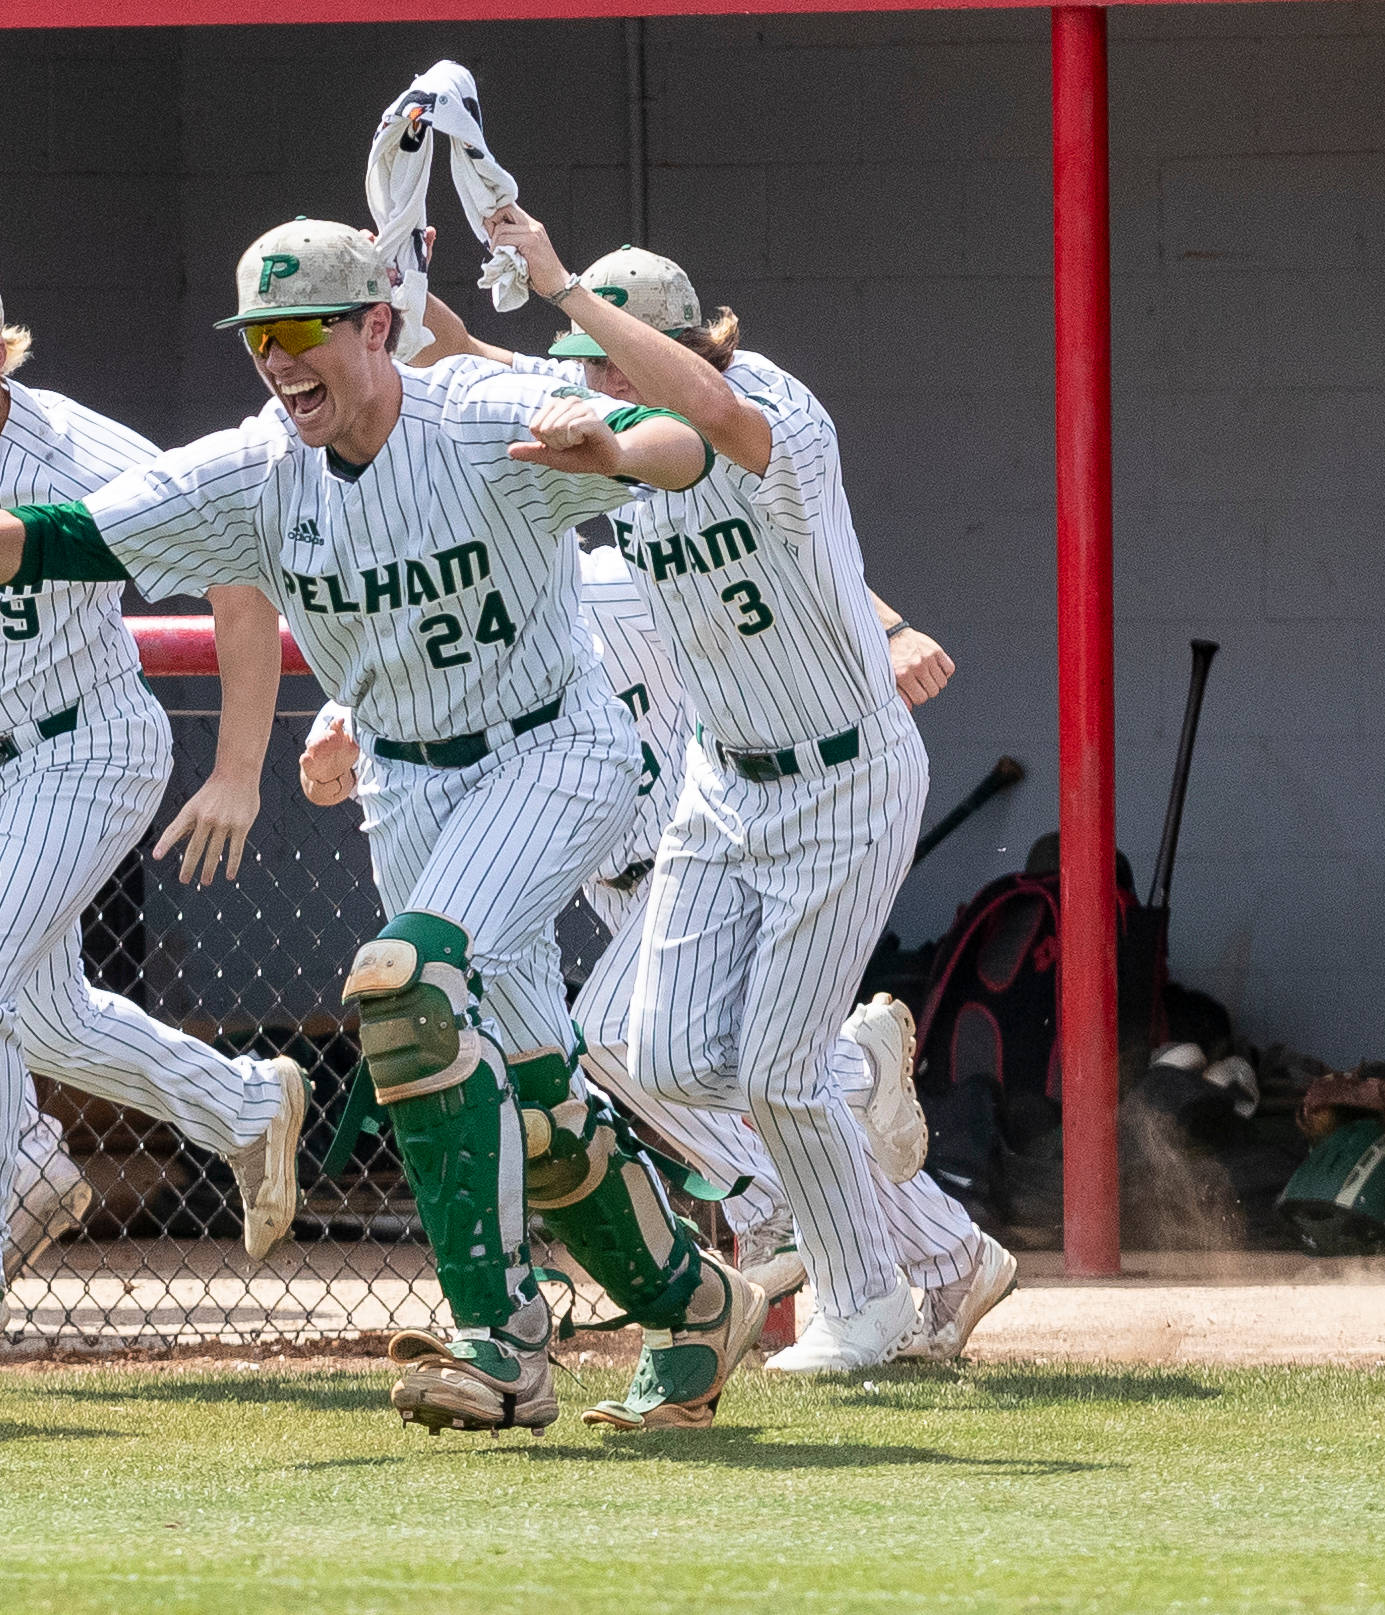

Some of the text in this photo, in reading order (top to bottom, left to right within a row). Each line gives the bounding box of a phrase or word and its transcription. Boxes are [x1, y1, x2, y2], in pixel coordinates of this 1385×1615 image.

[258, 254, 300, 294] P
[281, 540, 491, 615] PELHAM
[721, 580, 774, 636] 3
[419, 589, 517, 670] 24
